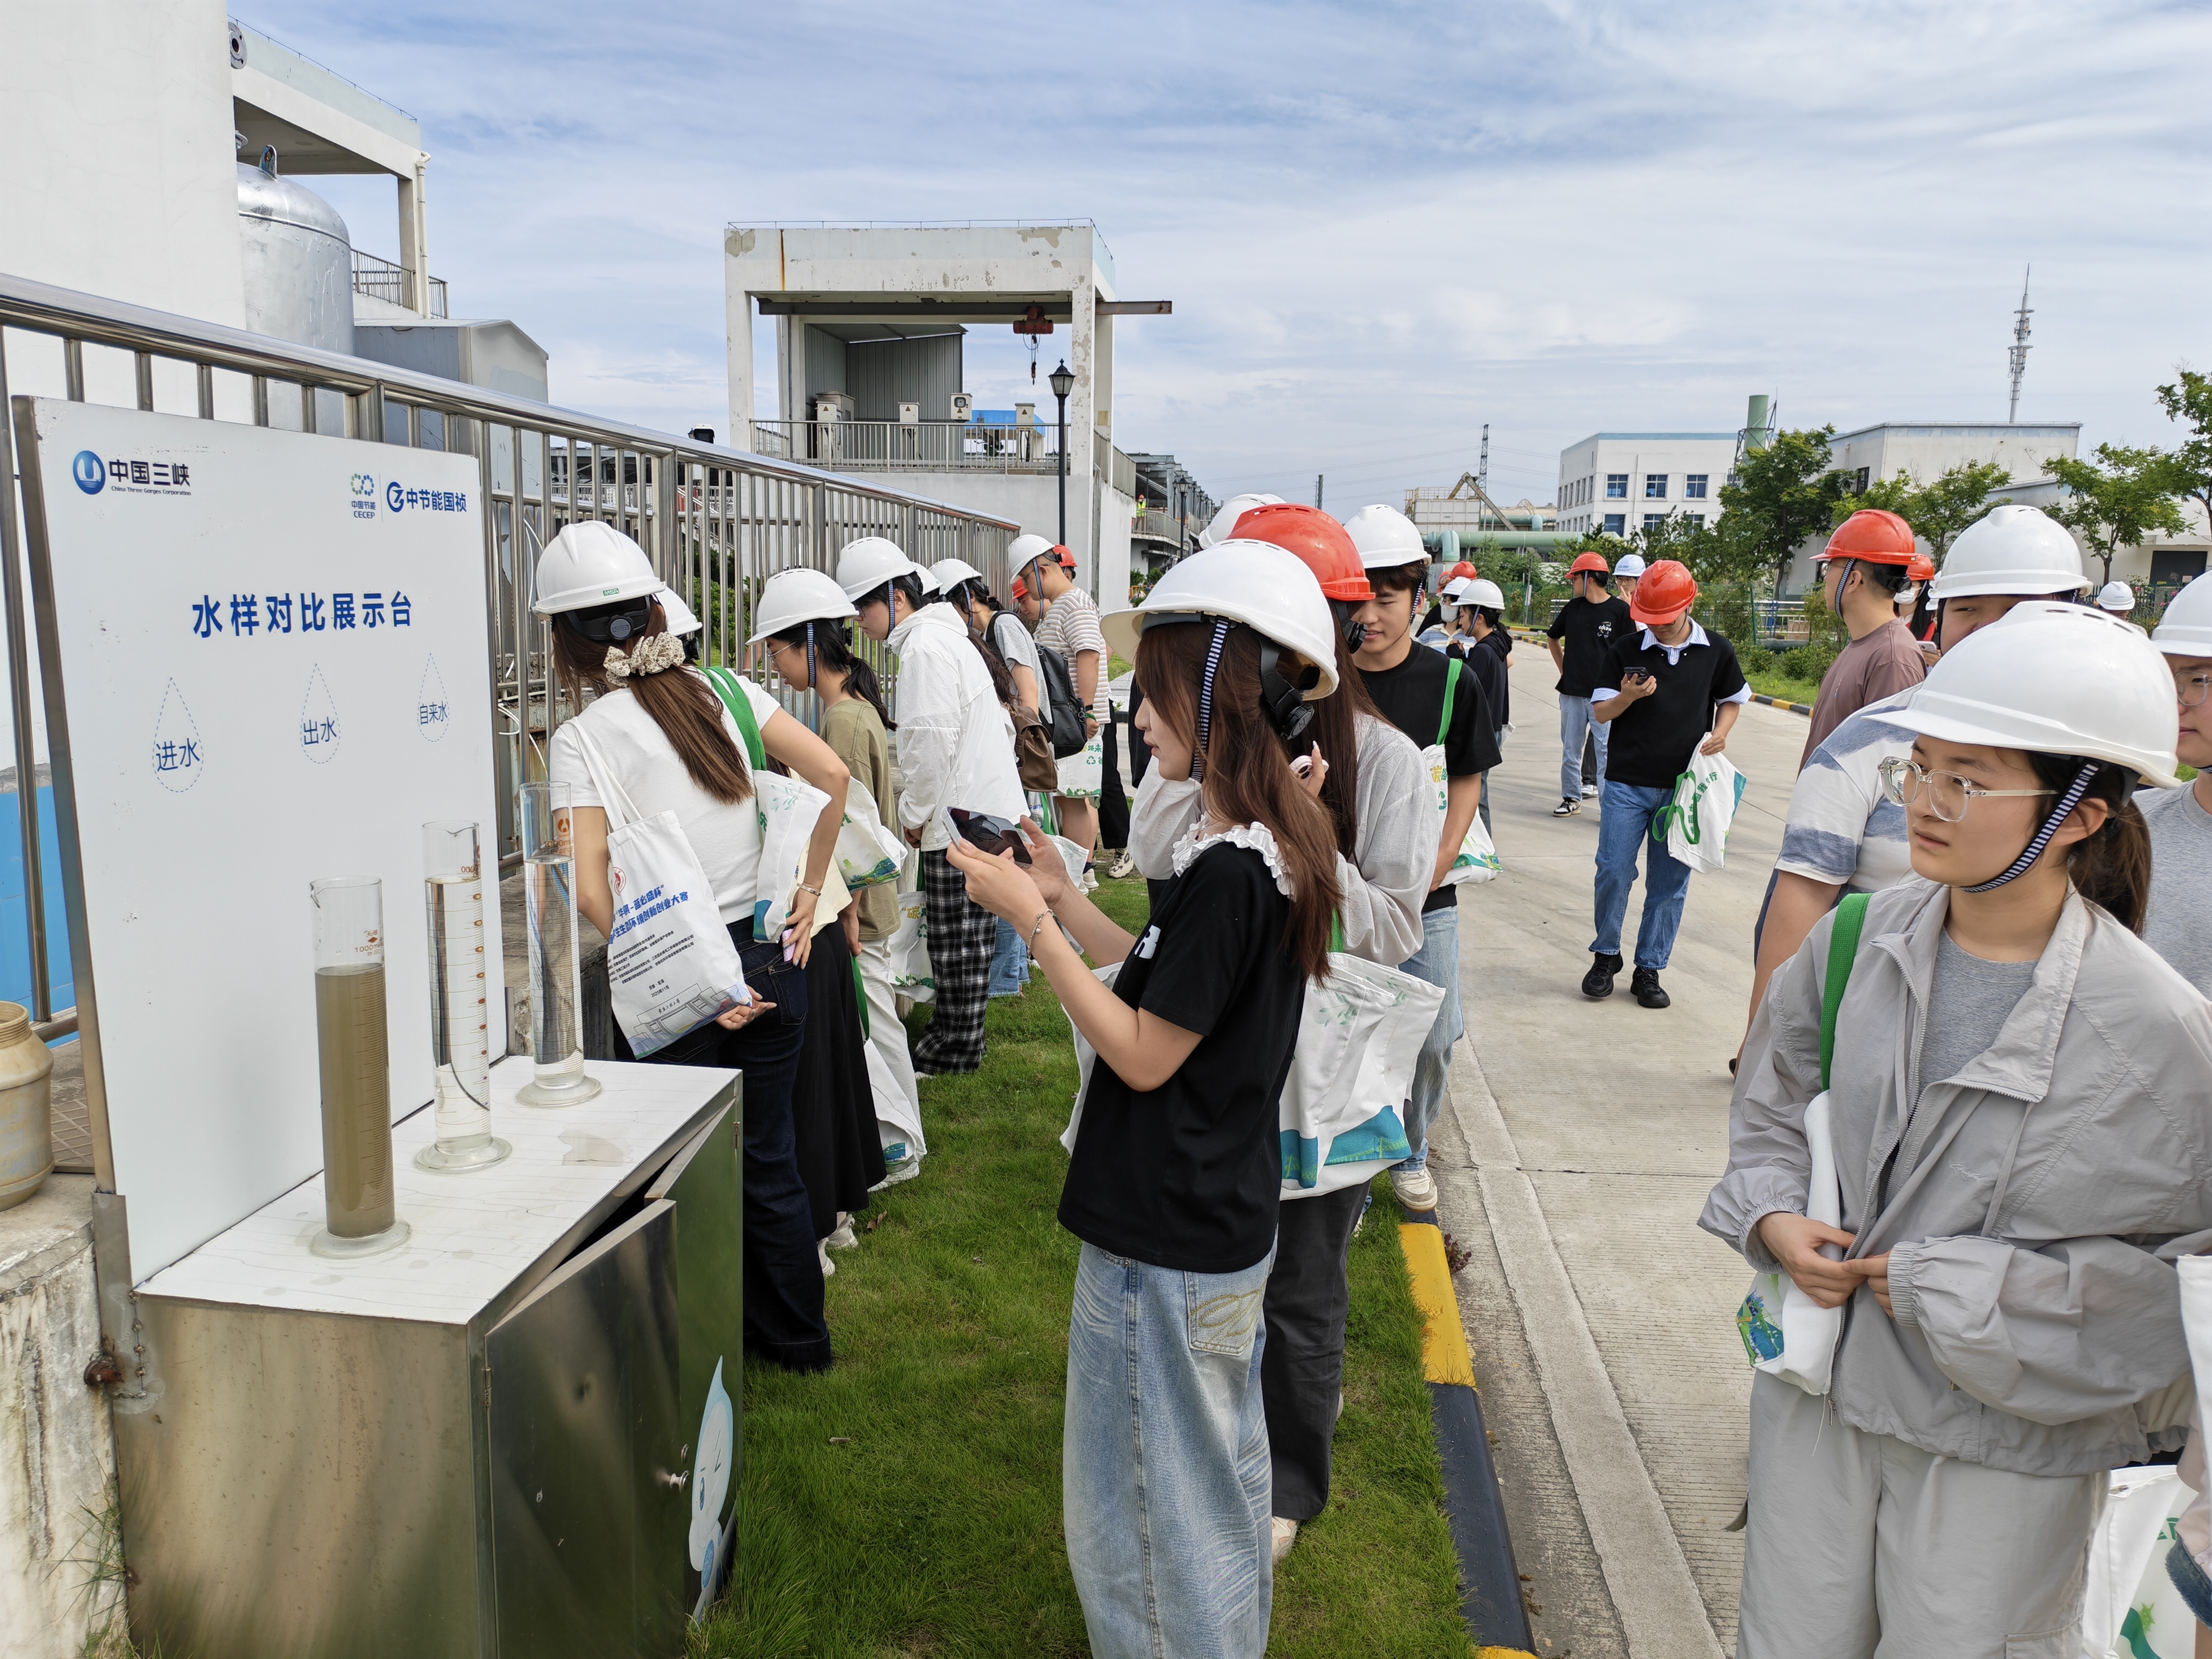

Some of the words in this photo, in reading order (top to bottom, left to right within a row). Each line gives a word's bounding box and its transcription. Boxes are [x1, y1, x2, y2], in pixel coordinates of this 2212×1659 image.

[109, 459, 191, 487] 中国三峡
[351, 500, 376, 510] 中国节能
[406, 488, 467, 513] 中节能国祯
[603, 588, 619, 596] MSA
[192, 591, 413, 639] 水样对比展示台
[612, 624, 629, 632] MSA
[419, 701, 448, 726] 自来水
[302, 717, 338, 746] 出水
[155, 737, 200, 773] 进水
